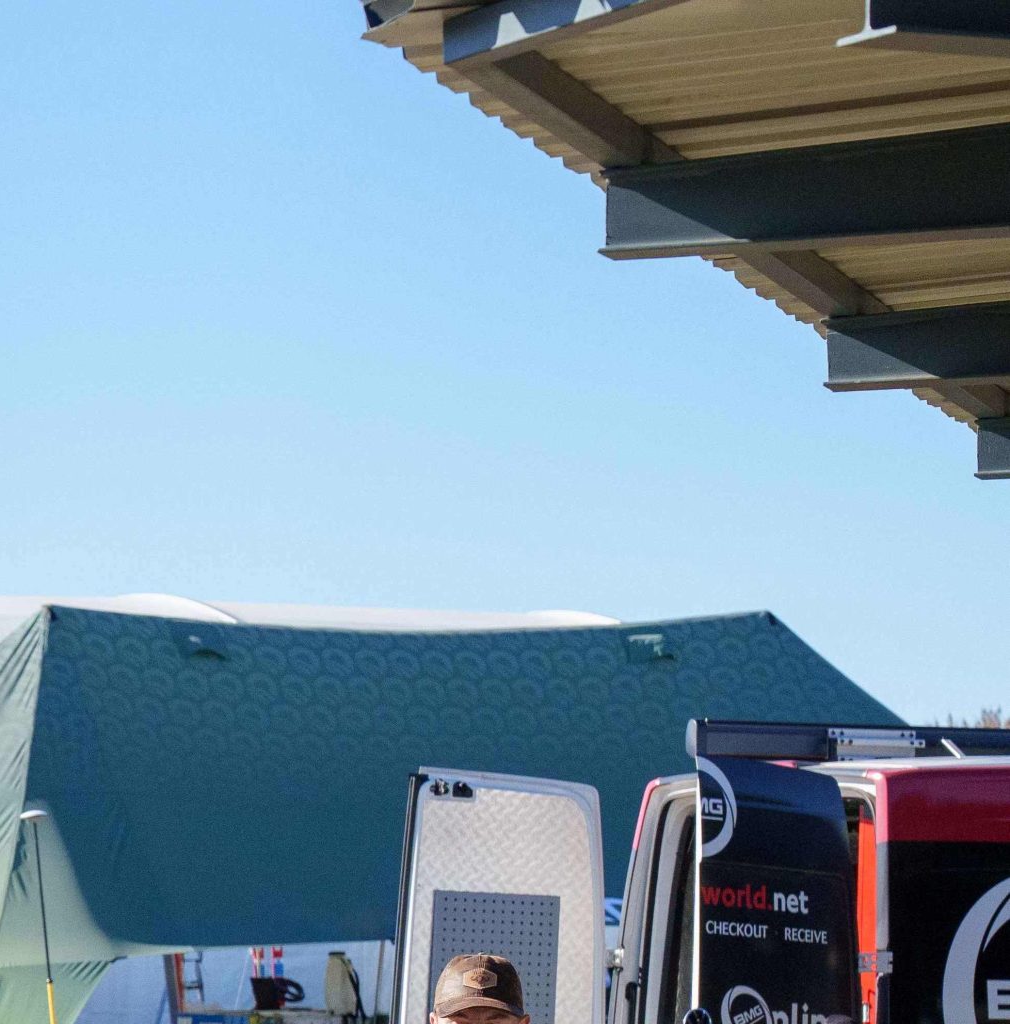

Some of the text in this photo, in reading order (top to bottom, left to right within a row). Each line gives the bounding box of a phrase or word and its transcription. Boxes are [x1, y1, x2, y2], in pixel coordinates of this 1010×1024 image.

[701, 884, 809, 915] world.net
[705, 920, 828, 944] CHECKOUT RECEIVE
